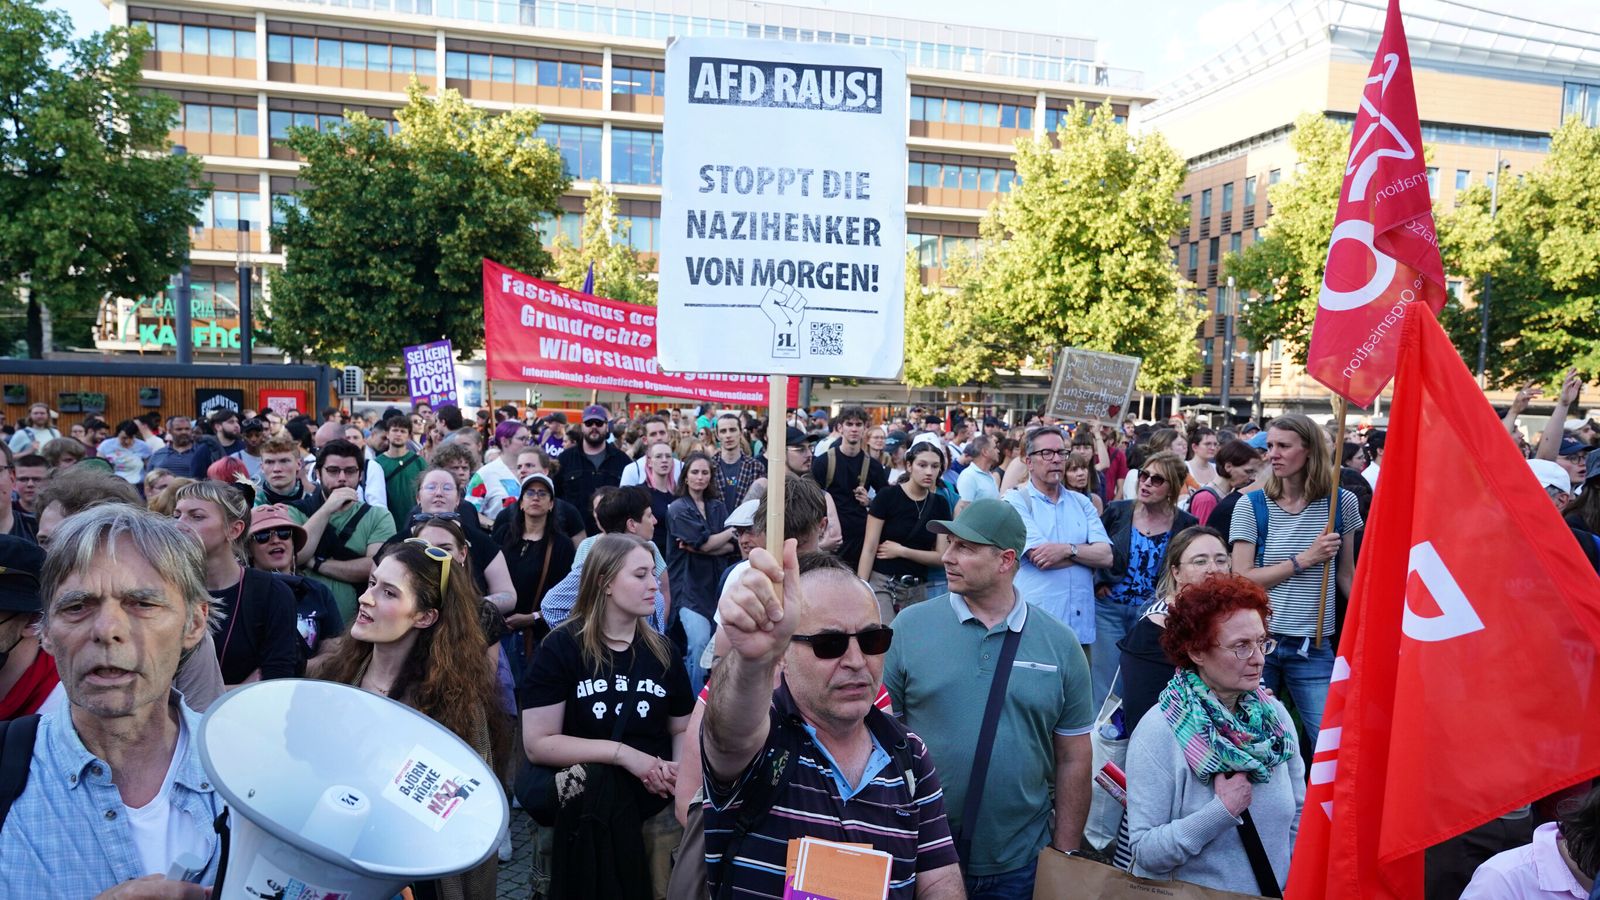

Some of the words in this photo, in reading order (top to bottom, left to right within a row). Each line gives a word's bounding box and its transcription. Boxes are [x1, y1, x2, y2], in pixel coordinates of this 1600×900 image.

[693, 62, 766, 102] AFD
[773, 67, 877, 109] RAUS!
[698, 164, 815, 197] STOPPT
[822, 169, 871, 201] DIE
[686, 209, 882, 247] NAZIHENKER
[685, 256, 744, 286] VON
[750, 258, 880, 293] MORGEN!
[152, 297, 216, 318] GARIA
[501, 273, 625, 323] Faschismus
[520, 304, 653, 348] Grundrechte
[407, 350, 425, 365] SEI
[424, 345, 449, 361] KEIN
[410, 358, 452, 379] ARSCH
[539, 337, 658, 375] Widerstand
[410, 372, 455, 398] LOCH
[522, 366, 584, 382] Internationale
[584, 374, 644, 389] Sozialistische
[577, 679, 608, 699] die
[615, 674, 667, 698] äzte
[399, 761, 428, 796] BJÖRN
[411, 768, 441, 803] HÖCKE
[427, 779, 460, 815] NAZI
